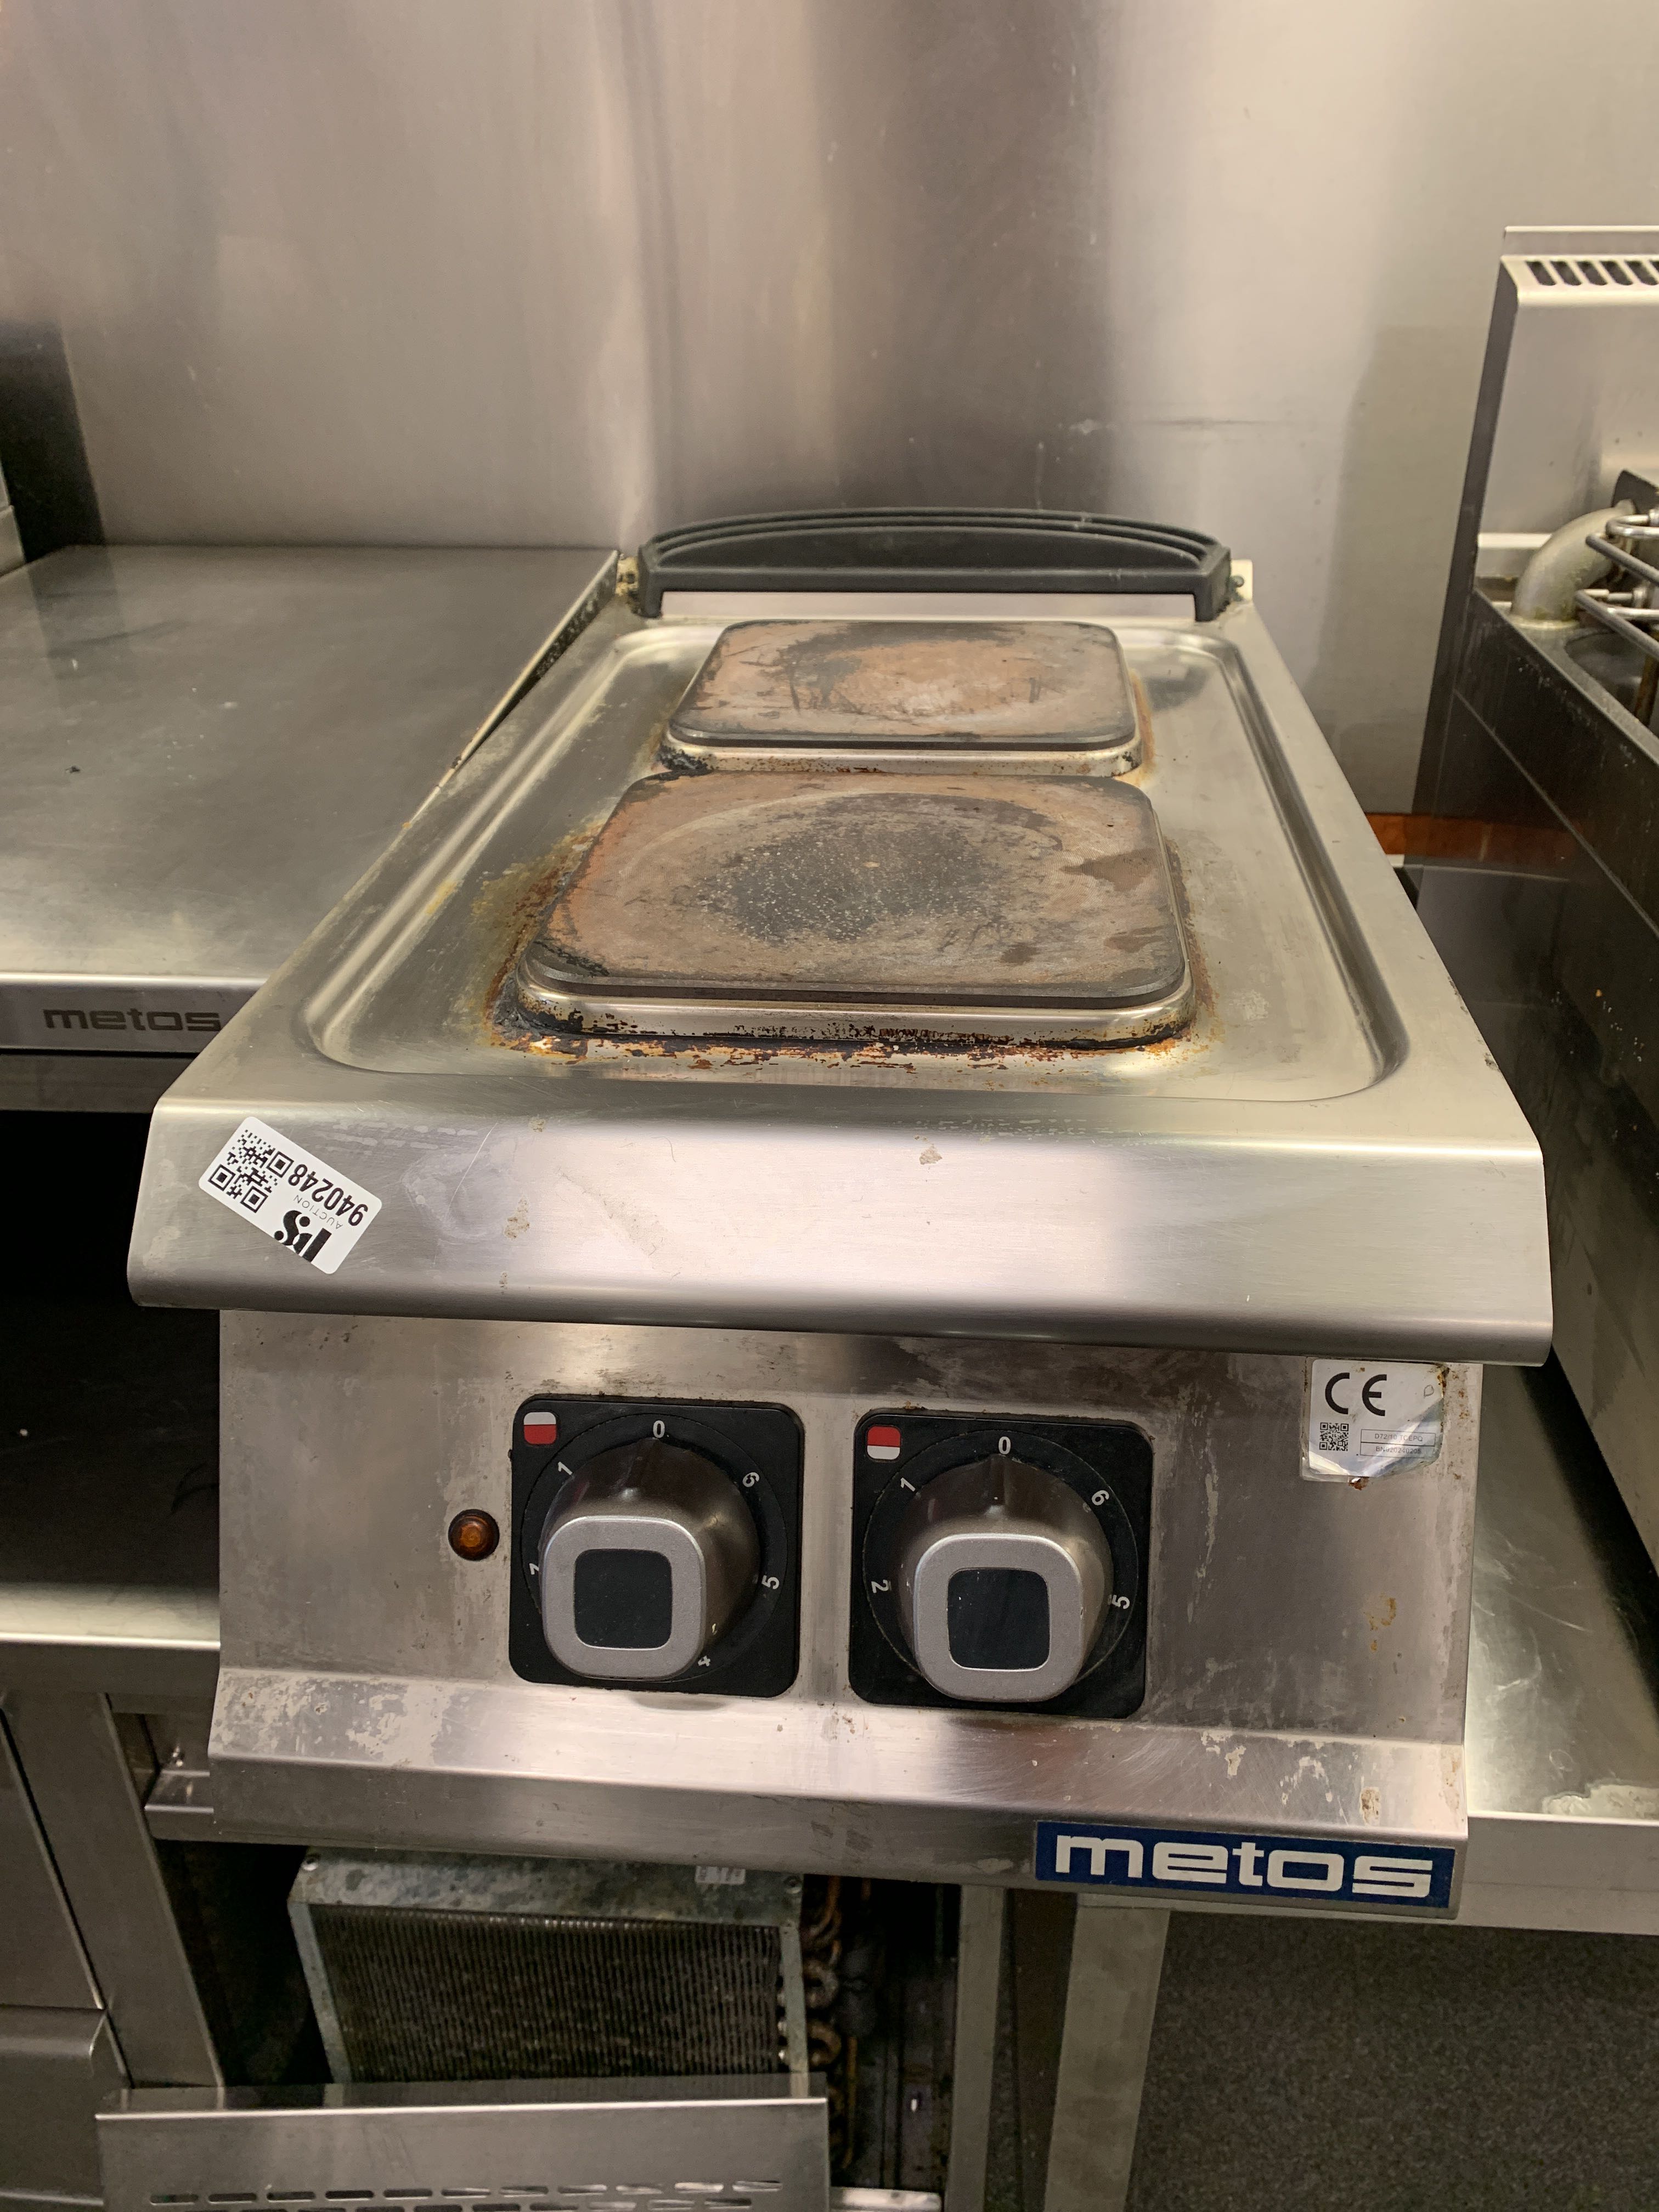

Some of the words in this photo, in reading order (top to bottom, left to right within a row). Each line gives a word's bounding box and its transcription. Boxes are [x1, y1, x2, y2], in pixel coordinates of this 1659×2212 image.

[43, 1008, 221, 1031] metos
[288, 1164, 368, 1227] 940248
[294, 1194, 343, 1229] AUCTION
[1325, 1372, 1387, 1417] CE
[653, 1420, 665, 1438] 0
[998, 1436, 1011, 1454] 0
[557, 1461, 573, 1476] 1
[900, 1477, 916, 1492] 1
[761, 1575, 780, 1589] 5
[871, 1579, 890, 1593] 2
[1111, 1595, 1130, 1609] 5
[1055, 1835, 1433, 1898] metos
